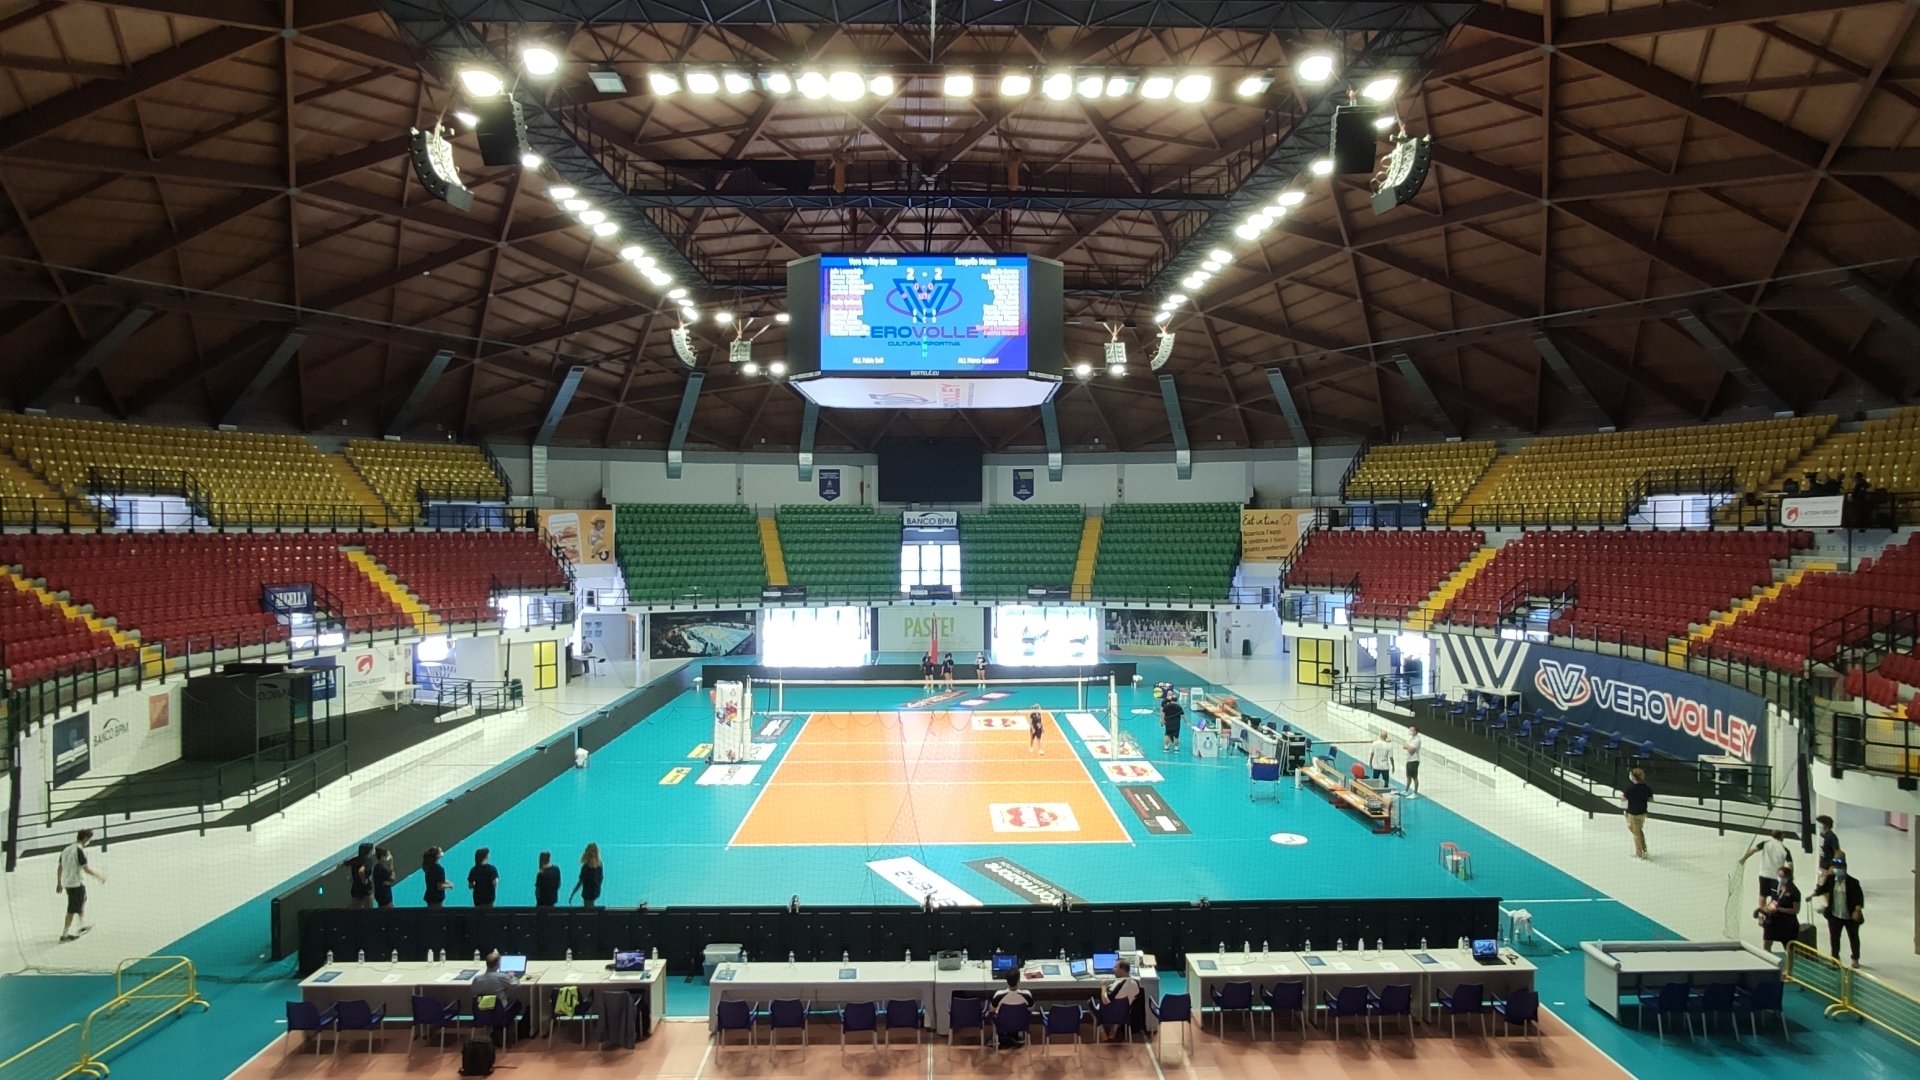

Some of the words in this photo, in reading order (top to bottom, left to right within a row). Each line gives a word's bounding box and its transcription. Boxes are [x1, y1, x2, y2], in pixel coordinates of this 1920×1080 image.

[906, 267, 915, 281] 2
[934, 267, 943, 281] 2
[906, 517, 937, 525] BANCO
[937, 517, 954, 525] BPM
[1242, 514, 1255, 525] Eat
[1263, 513, 1280, 525] time
[1261, 544, 1288, 552] preferiti!
[368, 676, 387, 684] GROUP
[1590, 675, 1757, 762] VEROVOLLEY
[93, 728, 113, 747] BANCO
[115, 722, 129, 736] BPM
